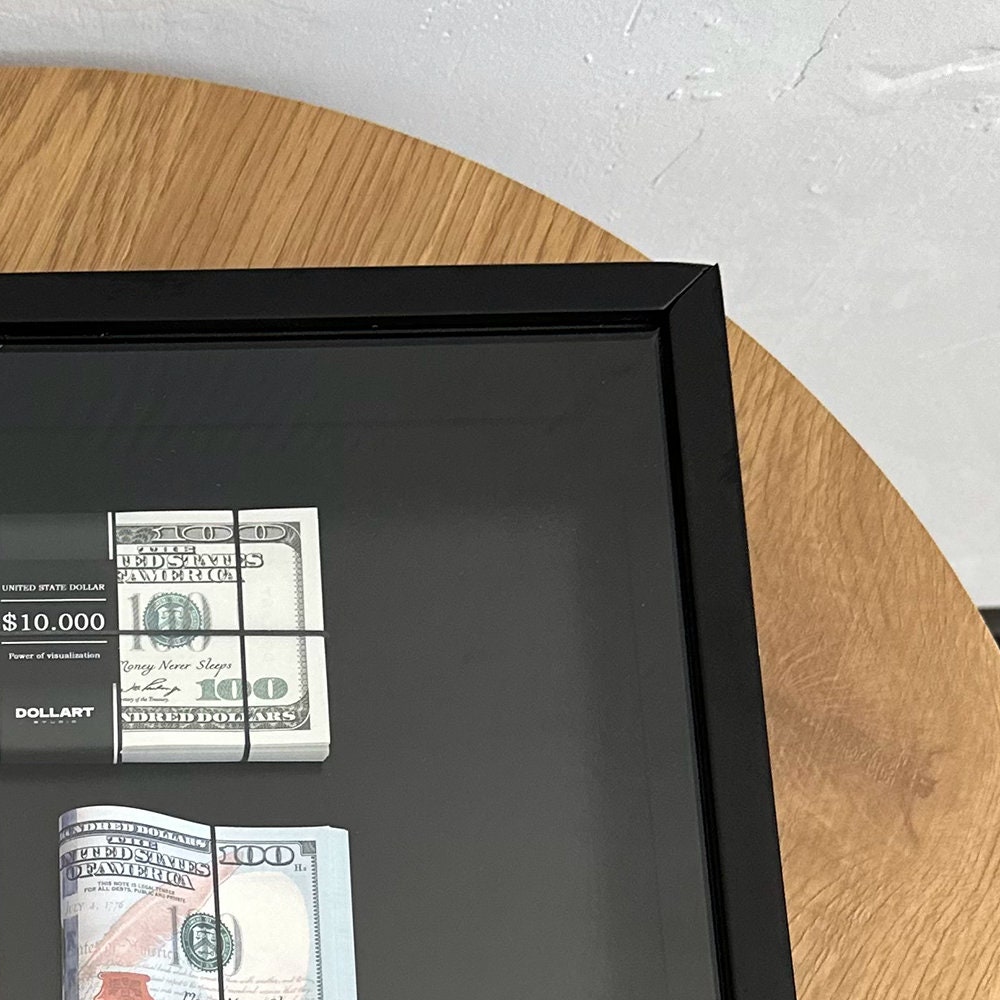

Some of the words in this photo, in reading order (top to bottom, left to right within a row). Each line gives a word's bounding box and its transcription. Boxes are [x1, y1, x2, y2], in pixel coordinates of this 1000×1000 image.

[2, 584, 37, 592] UNITED
[69, 583, 106, 591] DOLLAR
[2, 611, 105, 632] $10.000
[8, 652, 34, 660] Power
[196, 657, 232, 677] Sleeps
[196, 677, 288, 700] 100
[15, 707, 95, 718] DOLLART
[197, 710, 296, 722] DOLARS
[134, 848, 211, 877] STATES
[219, 845, 295, 866] 100
